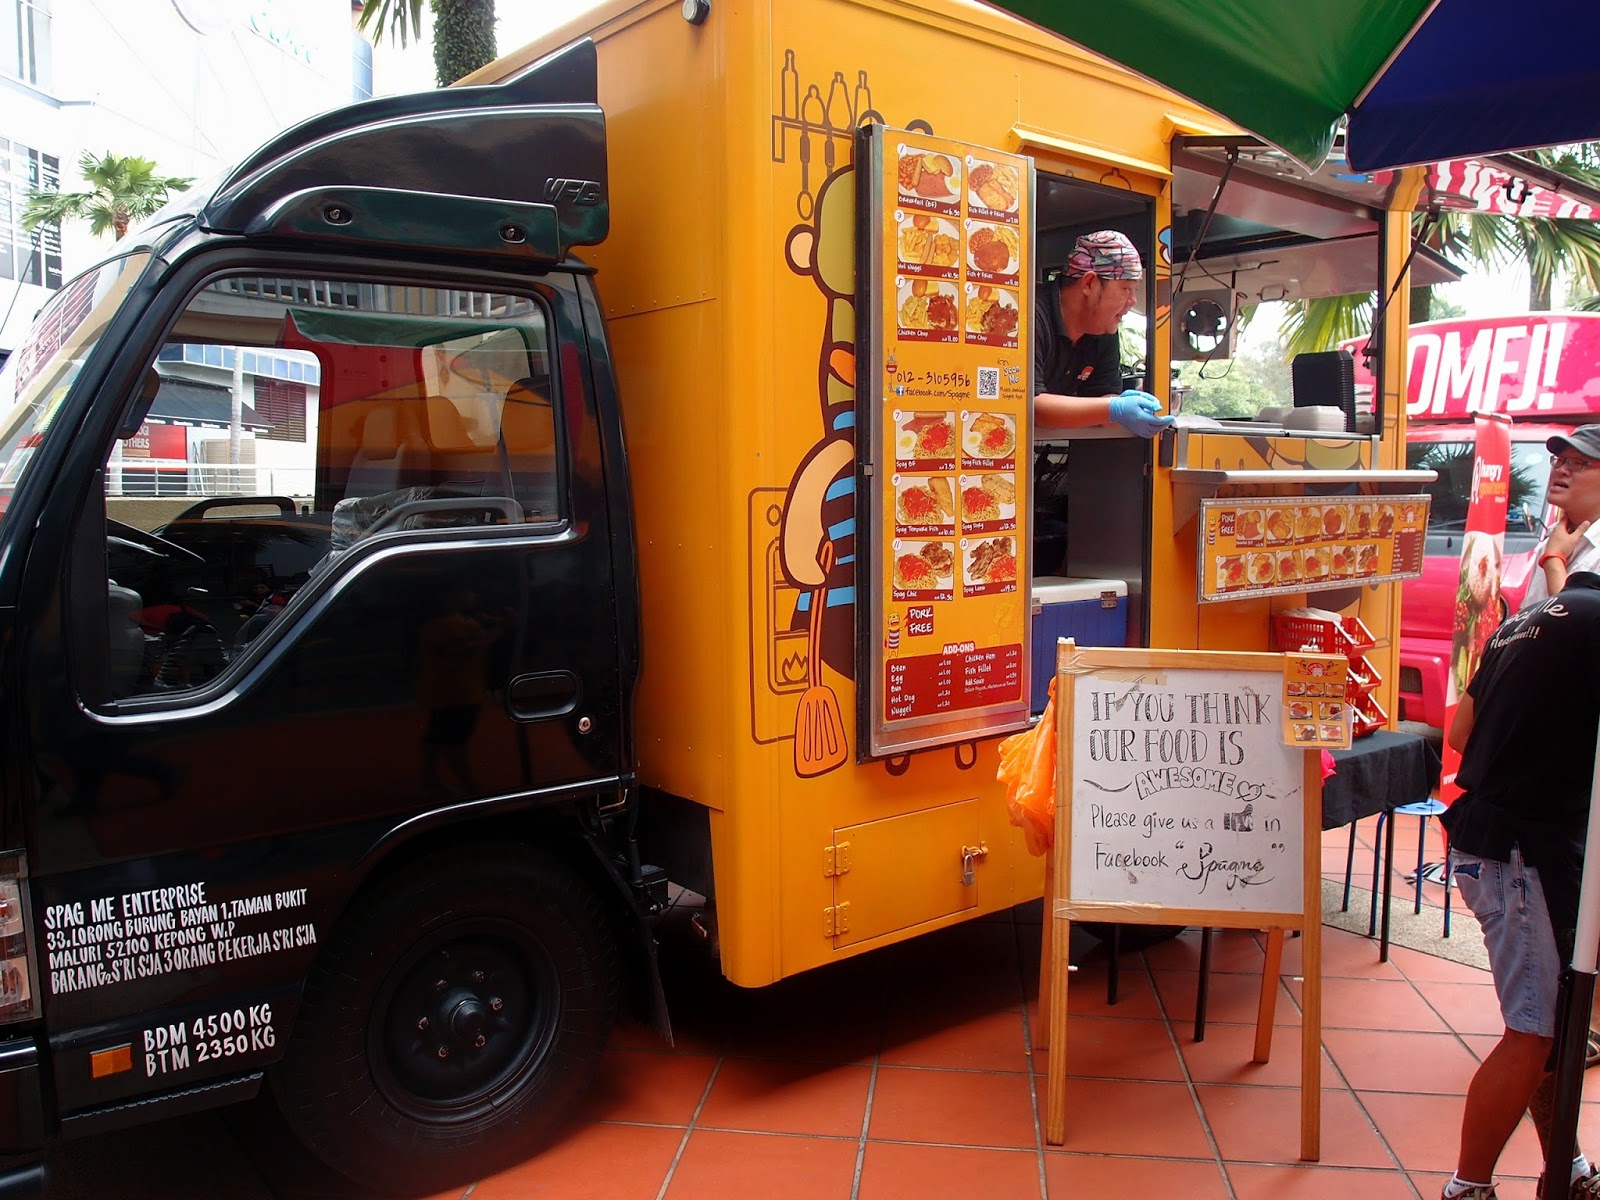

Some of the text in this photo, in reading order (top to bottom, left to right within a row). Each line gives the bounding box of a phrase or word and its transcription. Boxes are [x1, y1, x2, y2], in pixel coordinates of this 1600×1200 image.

[909, 607, 934, 619] PORK
[910, 623, 933, 634] FREE
[943, 643, 975, 655] ADD-ONS
[891, 675, 904, 685] Egg
[1091, 692, 1271, 725] IF YOU THINK
[1090, 728, 1245, 766] OUR FOOD IS
[1135, 767, 1237, 800] AWESOME
[1091, 804, 1281, 839] Please give us a in
[1095, 843, 1169, 871] Facebook
[44, 882, 207, 930] SPAG ME ENTERPRISE
[125, 912, 176, 938] BURUNG
[181, 904, 219, 928] BAYAN
[275, 888, 308, 910] BUKIT
[49, 944, 102, 970] MALURI
[106, 937, 150, 959] 52100
[155, 926, 207, 951] KEPONG
[218, 932, 272, 962] PEKERJA
[144, 1003, 272, 1052] BDM 4500 KG
[146, 1025, 276, 1078] BTM 2350 KG
